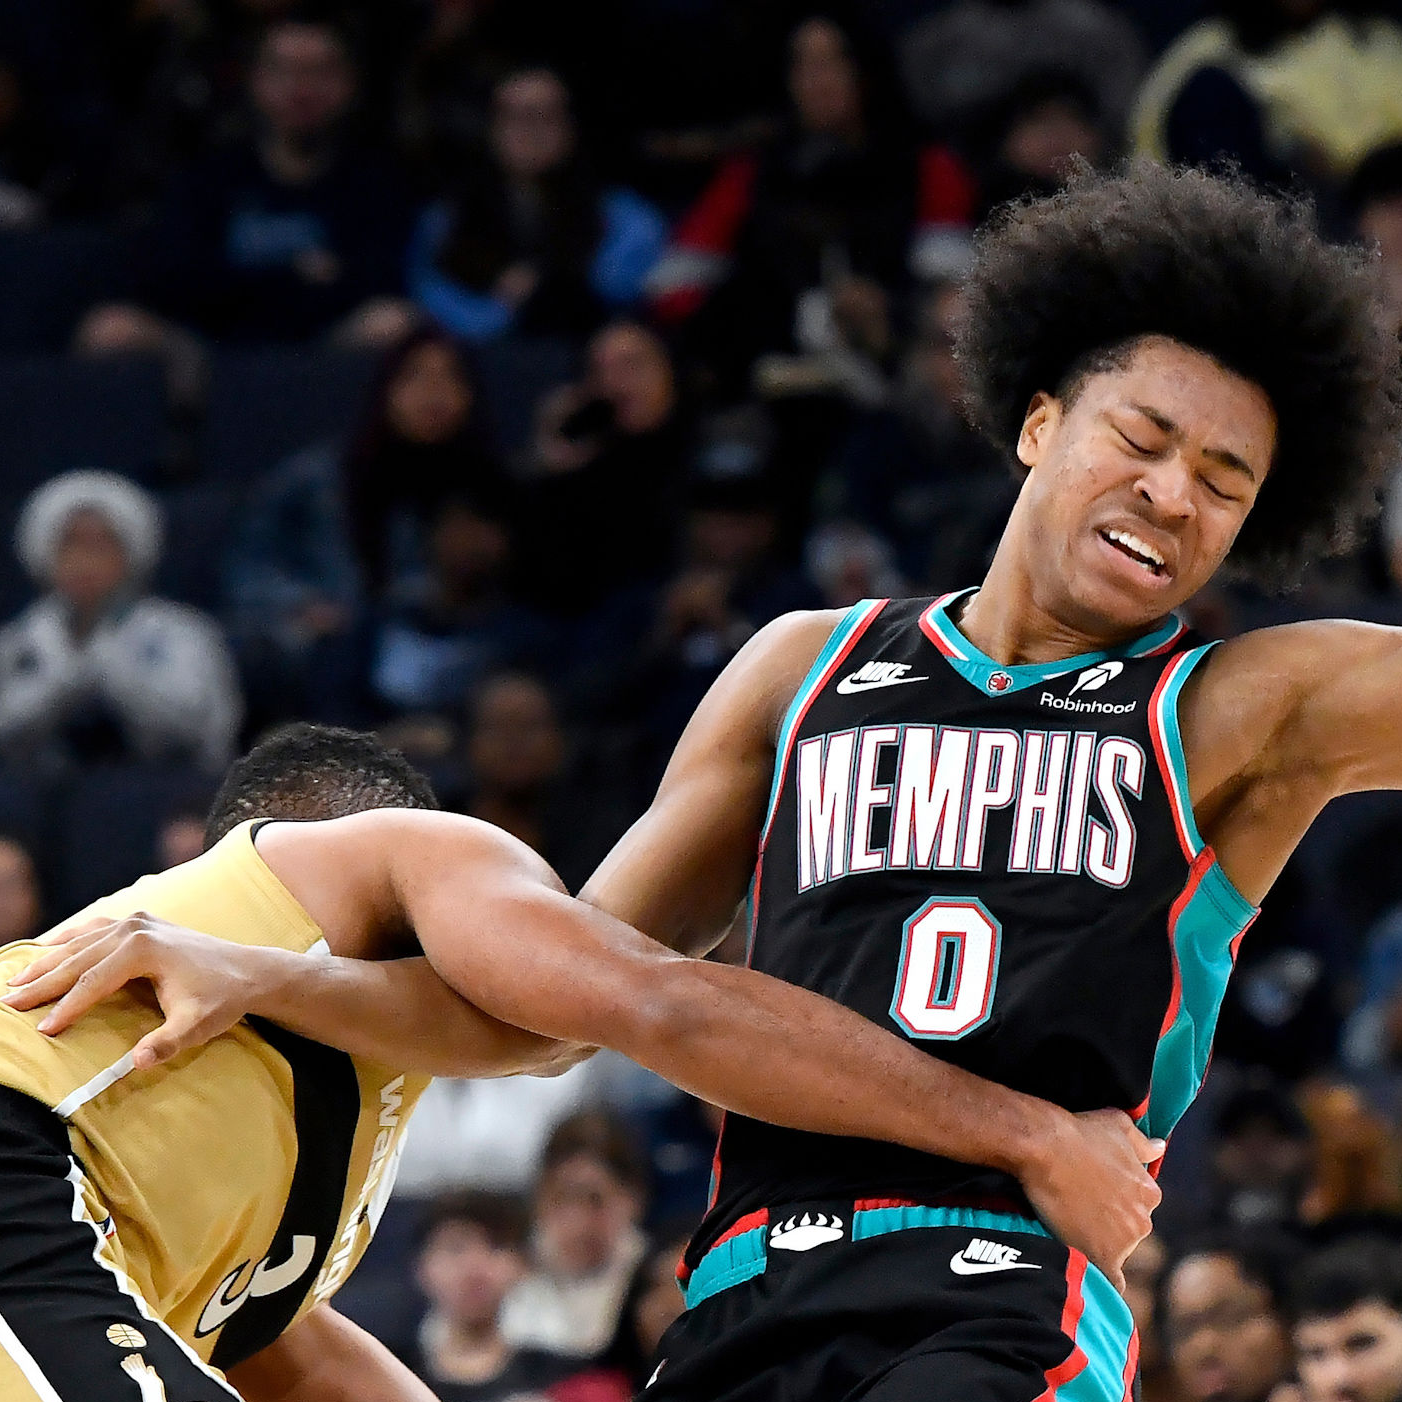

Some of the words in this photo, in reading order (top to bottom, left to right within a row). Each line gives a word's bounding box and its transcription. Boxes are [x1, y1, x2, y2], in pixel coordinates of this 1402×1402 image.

[851, 659, 914, 683] NIKE
[1039, 691, 1138, 716] Robinhood
[797, 723, 1147, 895] MEMPHIS
[888, 896, 1002, 1040] 0
[962, 1237, 1023, 1264] NIKE
